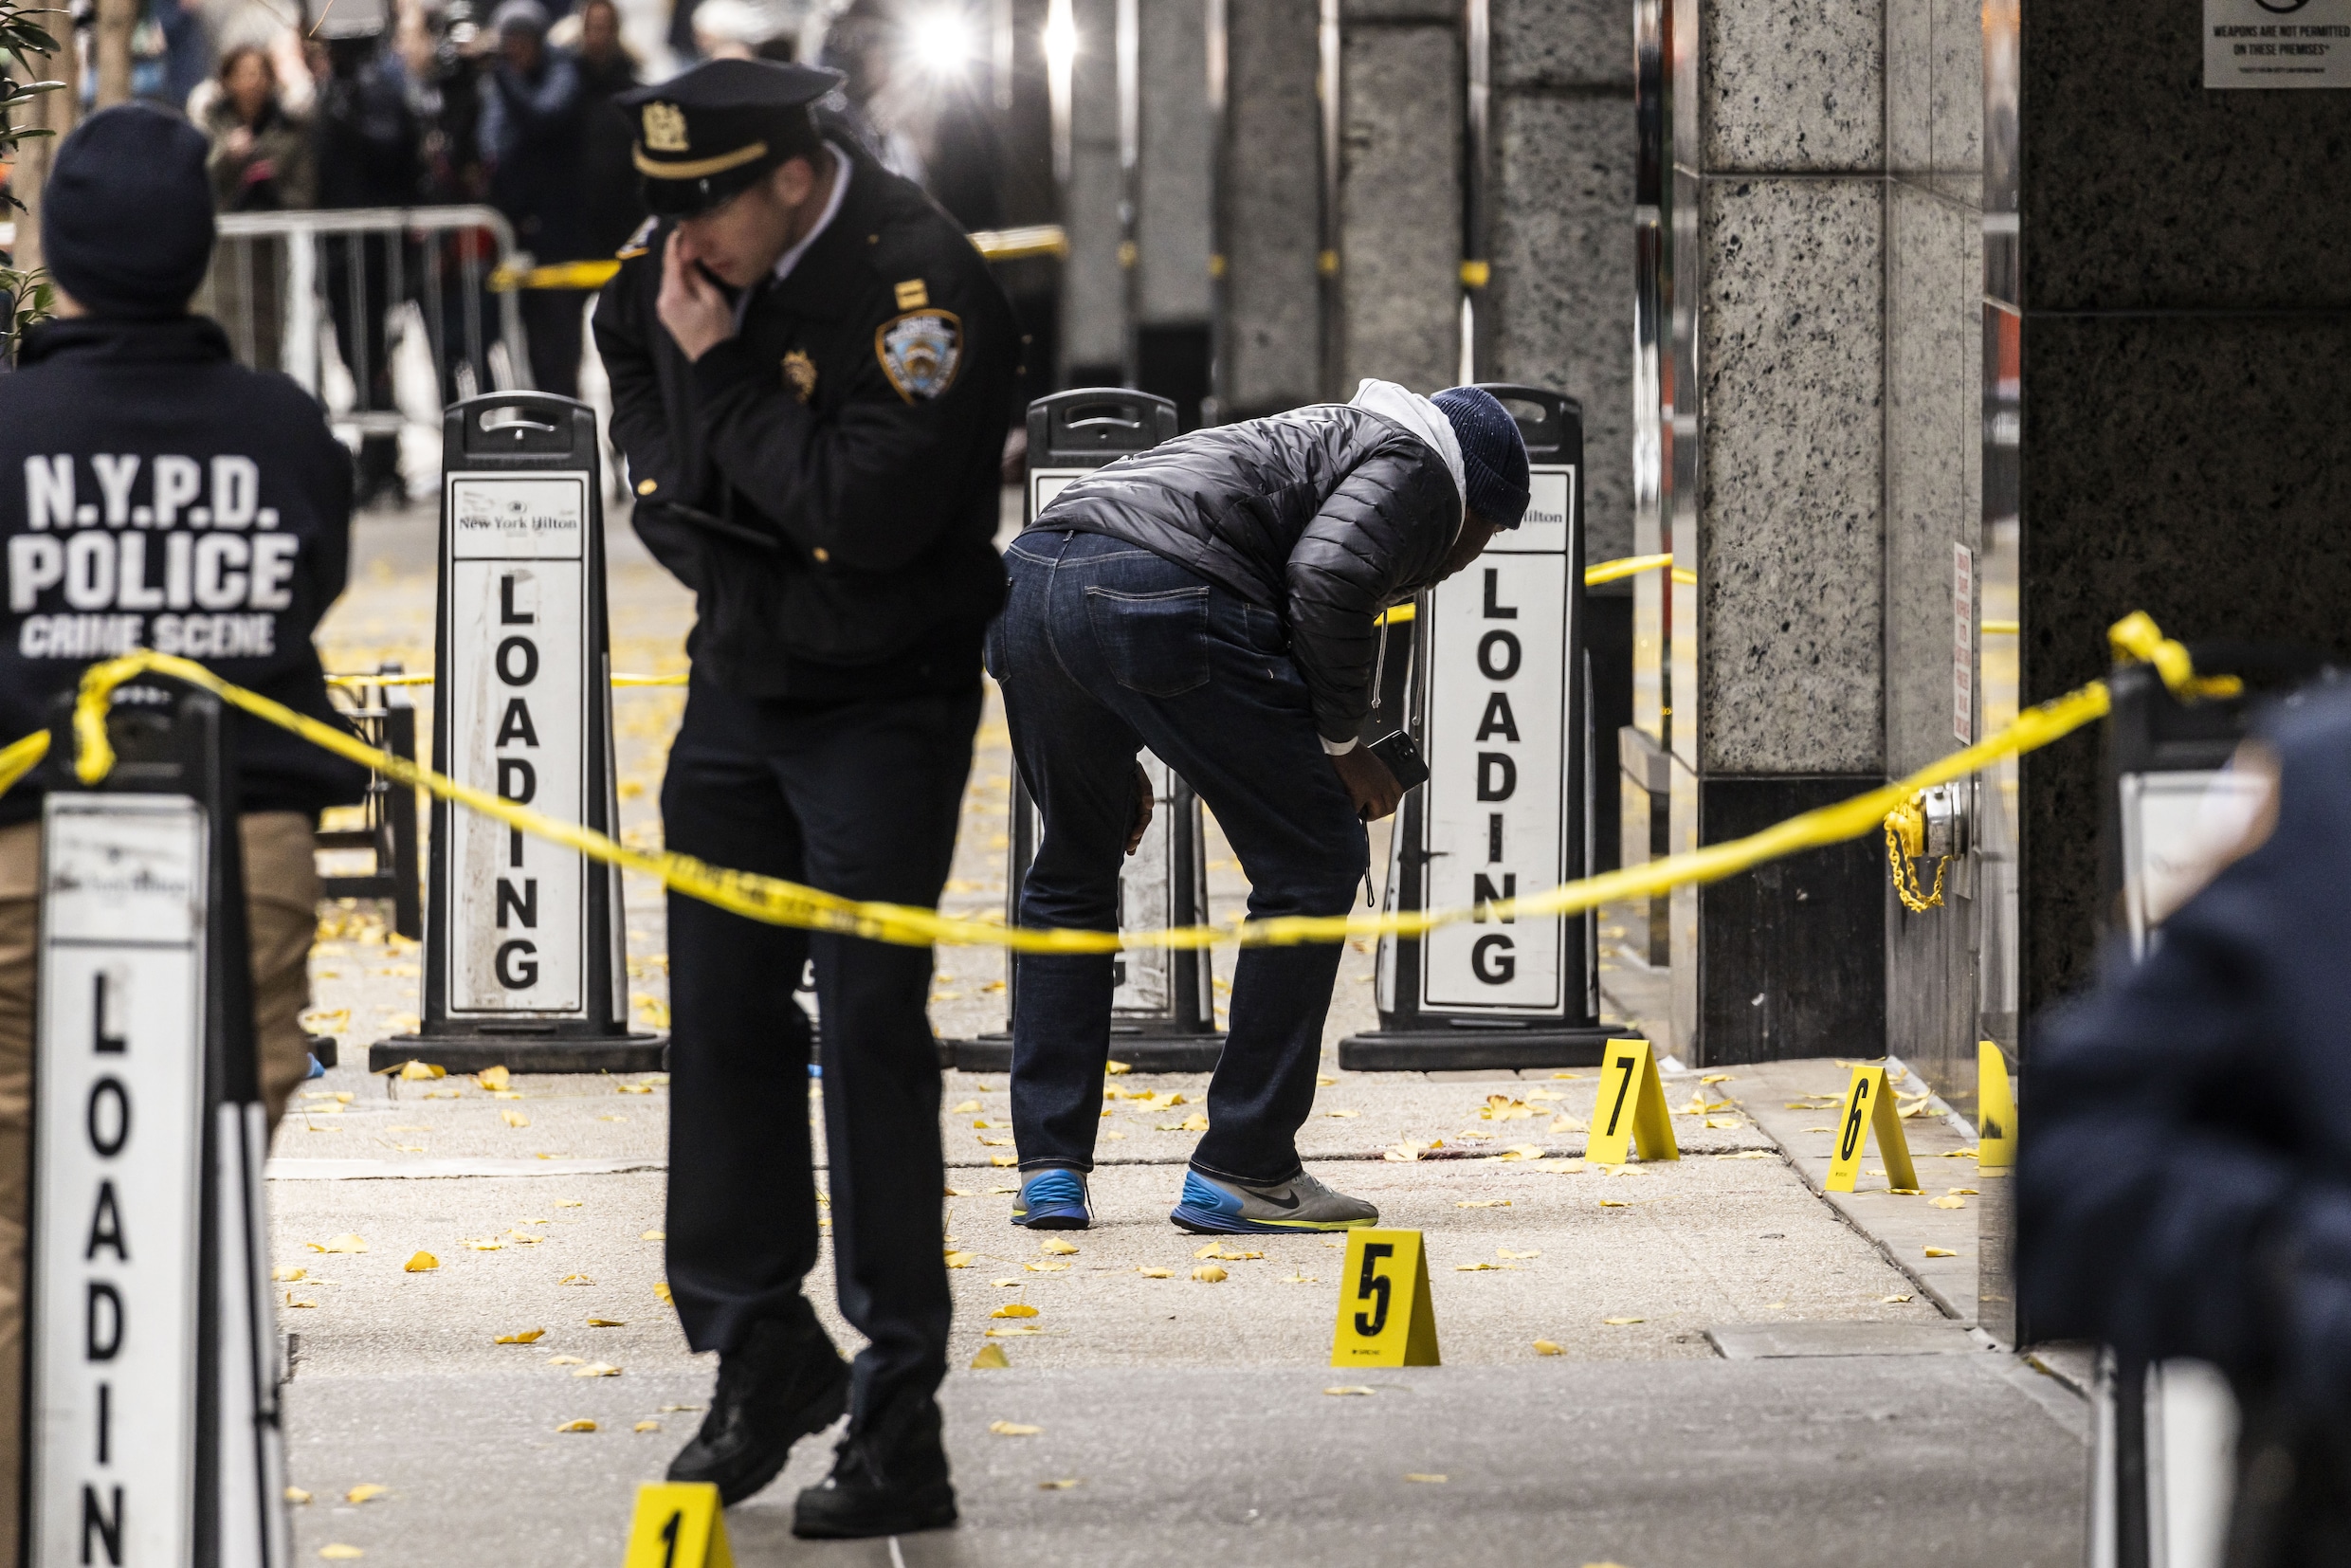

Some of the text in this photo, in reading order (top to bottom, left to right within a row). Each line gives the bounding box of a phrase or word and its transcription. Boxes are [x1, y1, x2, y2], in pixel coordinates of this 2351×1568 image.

[2214, 26, 2350, 37] WEAPONS ARE NOT PERMITTED
[2233, 44, 2247, 55] ON
[2250, 44, 2276, 55] THESE
[26, 455, 280, 530] N.Y.P.D.
[460, 516, 577, 530] New York Hilton
[8, 533, 300, 612] POLICE
[19, 613, 276, 658] CRIME SCENE
[495, 574, 539, 990] LOADING
[1471, 568, 1522, 986] LOADING
[1606, 1056, 1636, 1137] 7
[1841, 1078, 1869, 1161] 6
[1355, 1243, 1394, 1338] 5
